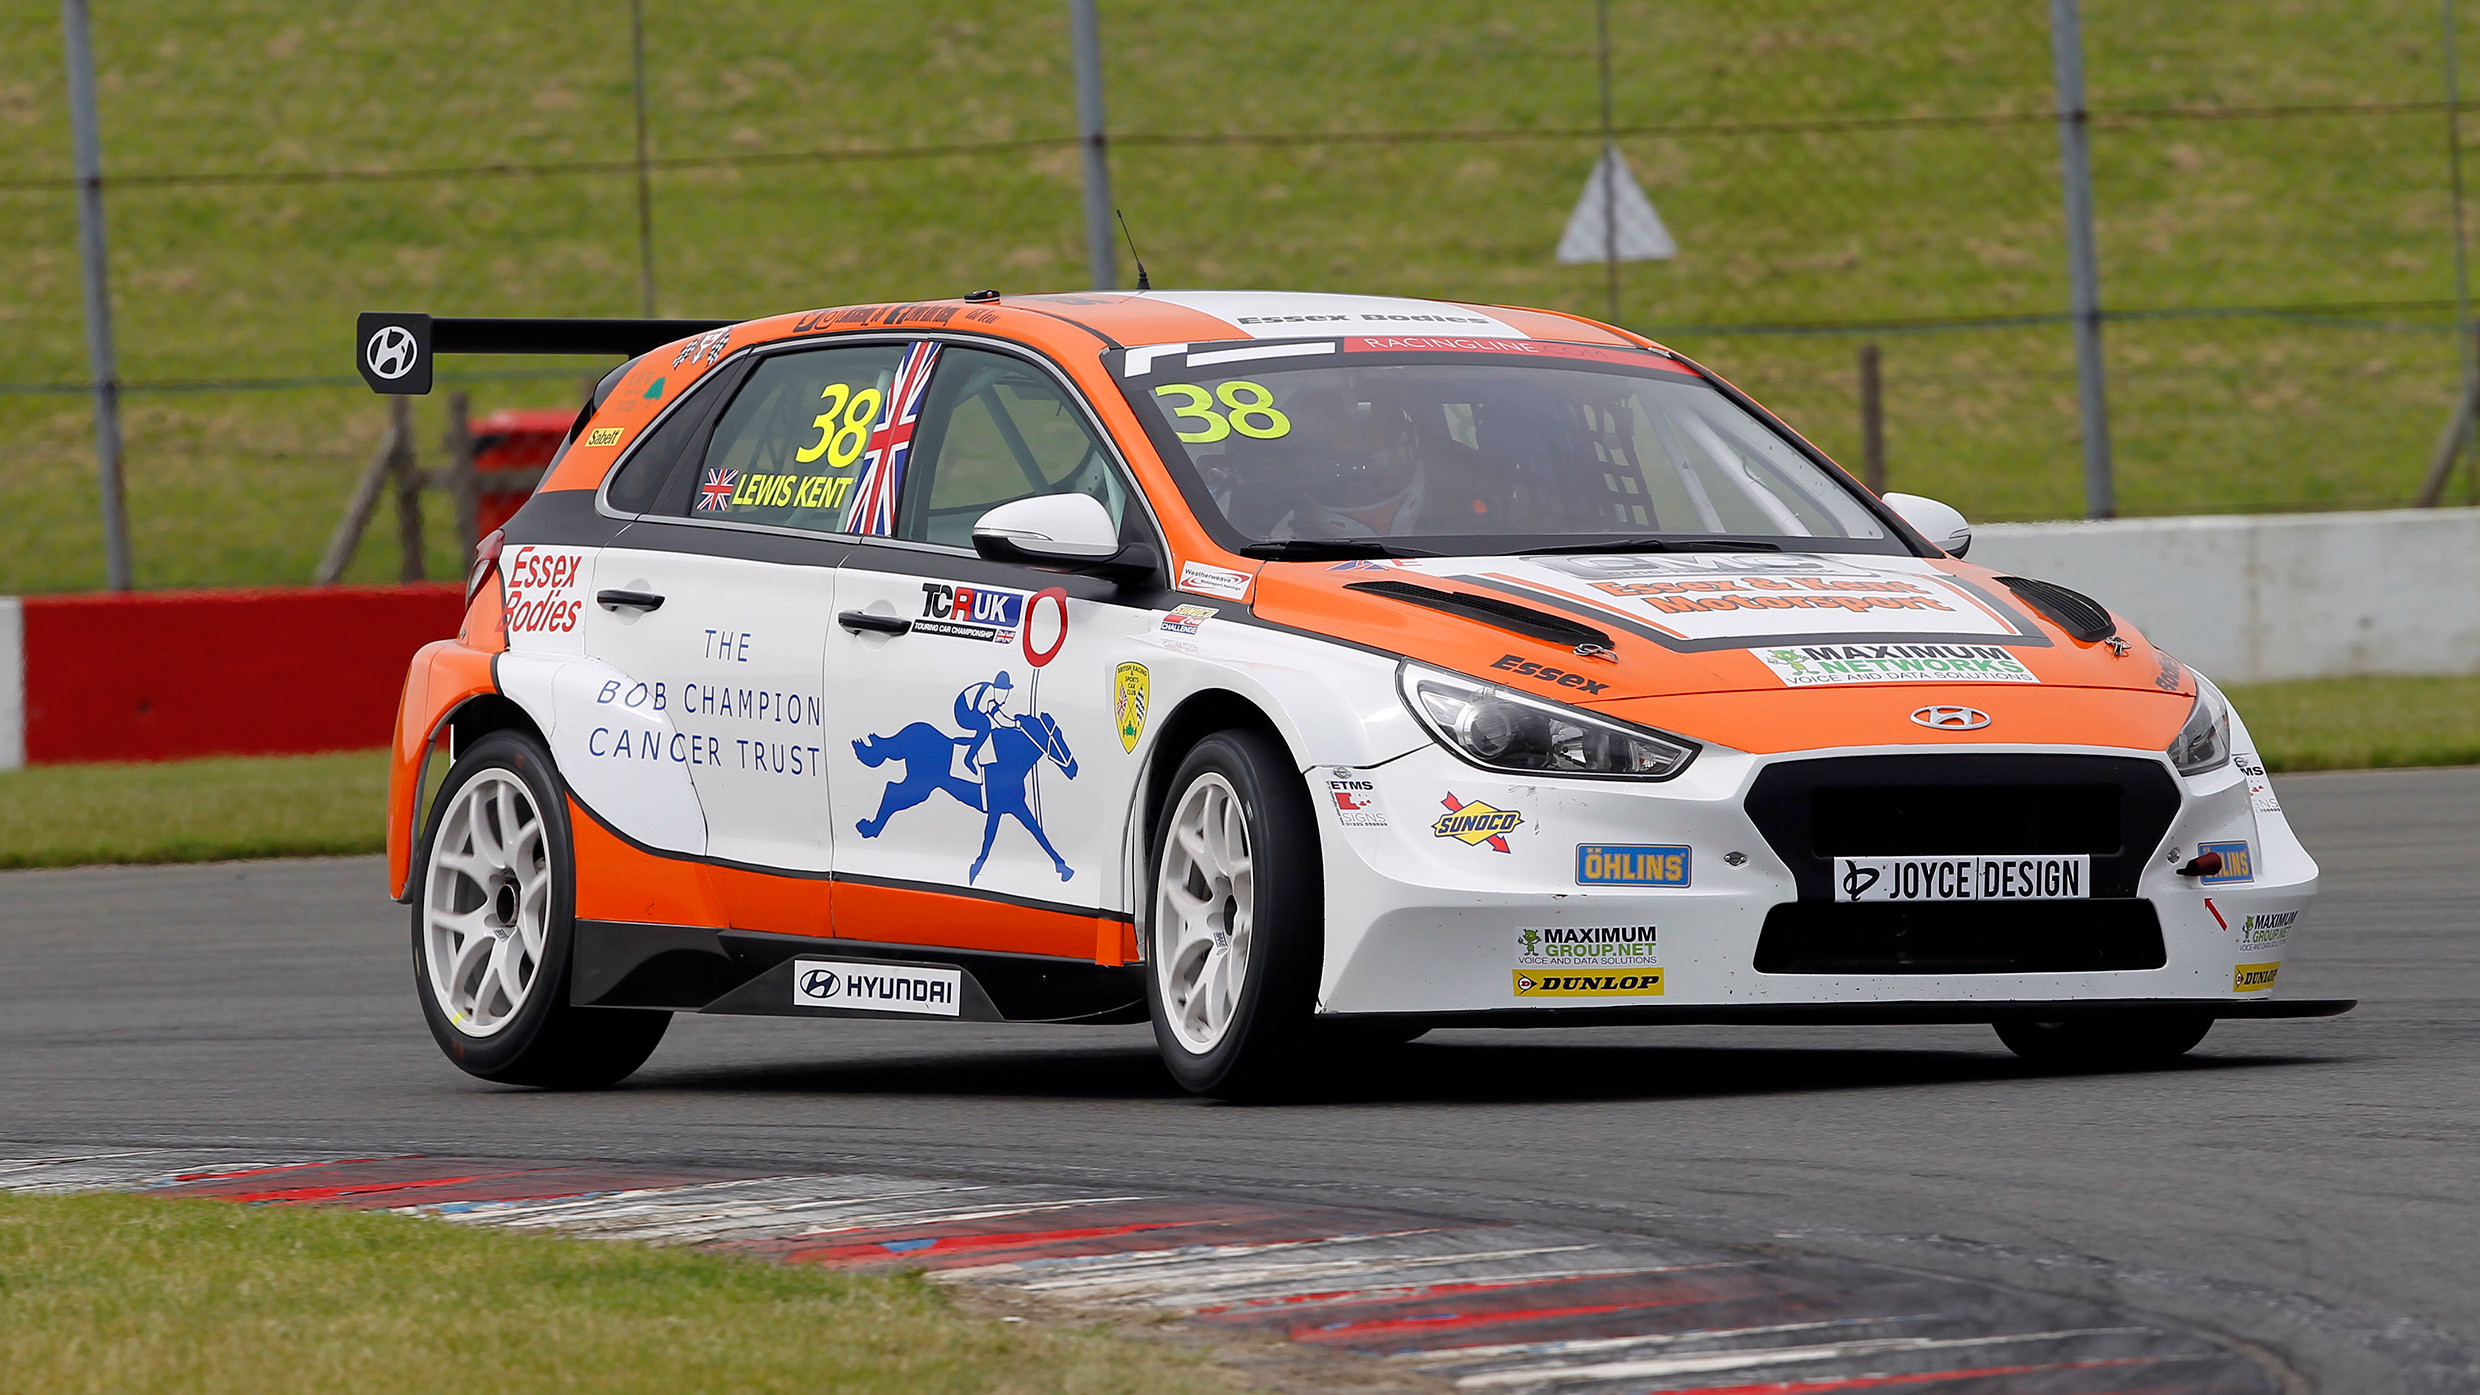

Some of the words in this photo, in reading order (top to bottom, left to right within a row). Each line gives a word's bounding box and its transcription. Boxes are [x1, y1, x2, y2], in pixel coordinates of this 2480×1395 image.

[1236, 313, 1351, 325] Essex
[1360, 313, 1490, 325] Bodies
[1154, 380, 1292, 444] 38
[795, 383, 881, 468] 38
[588, 429, 619, 445] Sabelt
[732, 473, 797, 508] LEWIS
[793, 475, 854, 509] KENT
[508, 546, 582, 588] Essex
[1185, 568, 1232, 583] Weatherweave
[1586, 580, 1755, 597] Essex
[1740, 576, 1803, 592] &
[1784, 576, 1933, 596] Kent
[495, 591, 582, 633] Bodies
[1640, 594, 1957, 614] Motorsport
[914, 621, 938, 632] TOURING
[939, 624, 951, 634] CAR
[951, 626, 994, 639] CHAMPIONSHIP
[1162, 622, 1198, 634] CHALLENGE
[704, 629, 751, 662] THE
[1801, 645, 2019, 661] MAXIMUM
[1490, 654, 1610, 695] Essex
[1819, 658, 2025, 675] NETWORKS
[1786, 674, 1841, 685] VOICE
[1847, 672, 1882, 681] AND
[1886, 671, 1930, 680] DATA
[1934, 671, 2033, 682] SOLUTIONS
[597, 680, 667, 711] BOB
[683, 683, 821, 726] CHAMPION
[588, 727, 722, 767] CANCER
[736, 739, 820, 777] TRUST
[2240, 766, 2264, 776] MS
[1330, 780, 1374, 790] ETMS
[1342, 812, 1386, 823] SIGNS
[1438, 812, 1517, 834] SUNOCO
[1585, 847, 1683, 880] ÖHLINS
[2202, 847, 2249, 878] LINS
[1889, 861, 1971, 899] JOYCE
[1983, 860, 2080, 898] DESIGN
[2254, 910, 2299, 930] MAXIMUM
[1544, 926, 1656, 943] MAXIMUM
[1518, 957, 1548, 965] VOICE
[1550, 957, 1571, 965] AND
[1573, 957, 1598, 965] DATA
[1600, 955, 1657, 964] SOLUTIONS
[1545, 943, 1656, 957] GROUP.NET
[1540, 975, 1660, 990] DUNLOP
[2244, 968, 2279, 985] DUNLOP
[847, 975, 952, 1004] HYUNDAI
